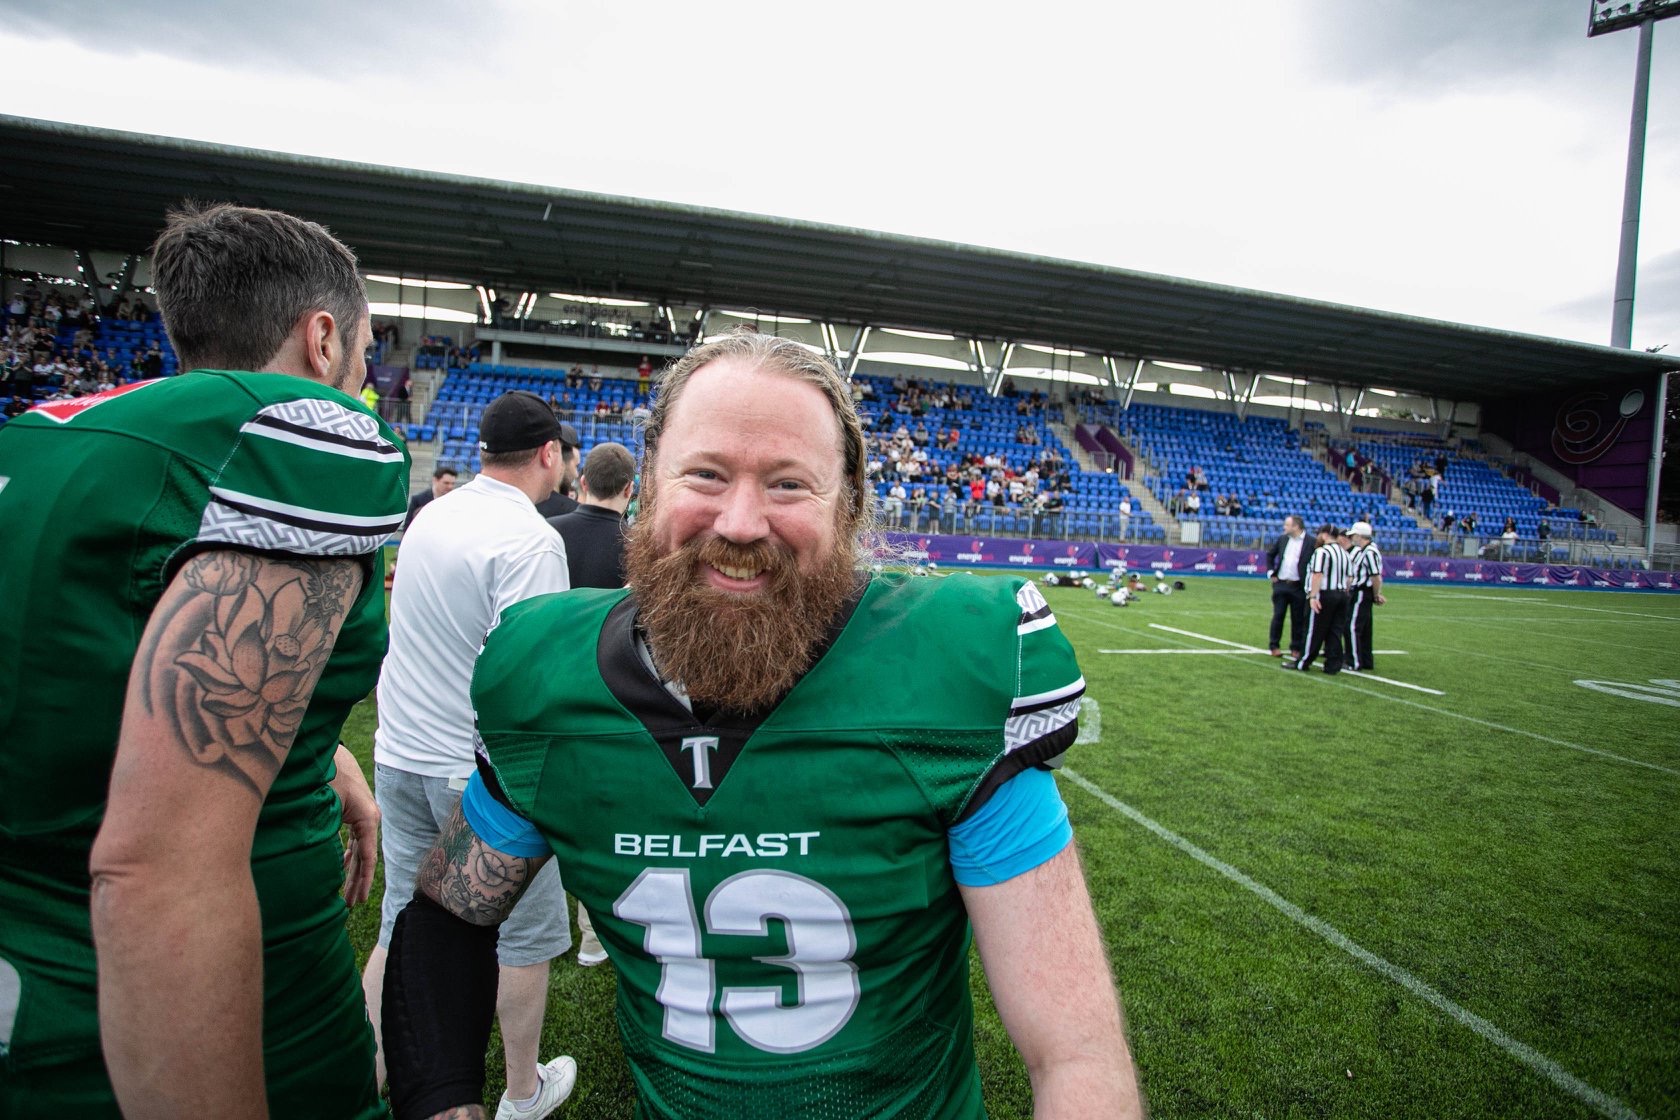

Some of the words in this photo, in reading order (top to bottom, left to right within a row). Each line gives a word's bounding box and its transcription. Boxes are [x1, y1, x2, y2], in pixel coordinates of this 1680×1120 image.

[680, 736, 719, 789] T
[614, 831, 820, 857] BELFAST
[613, 867, 861, 1054] 13
